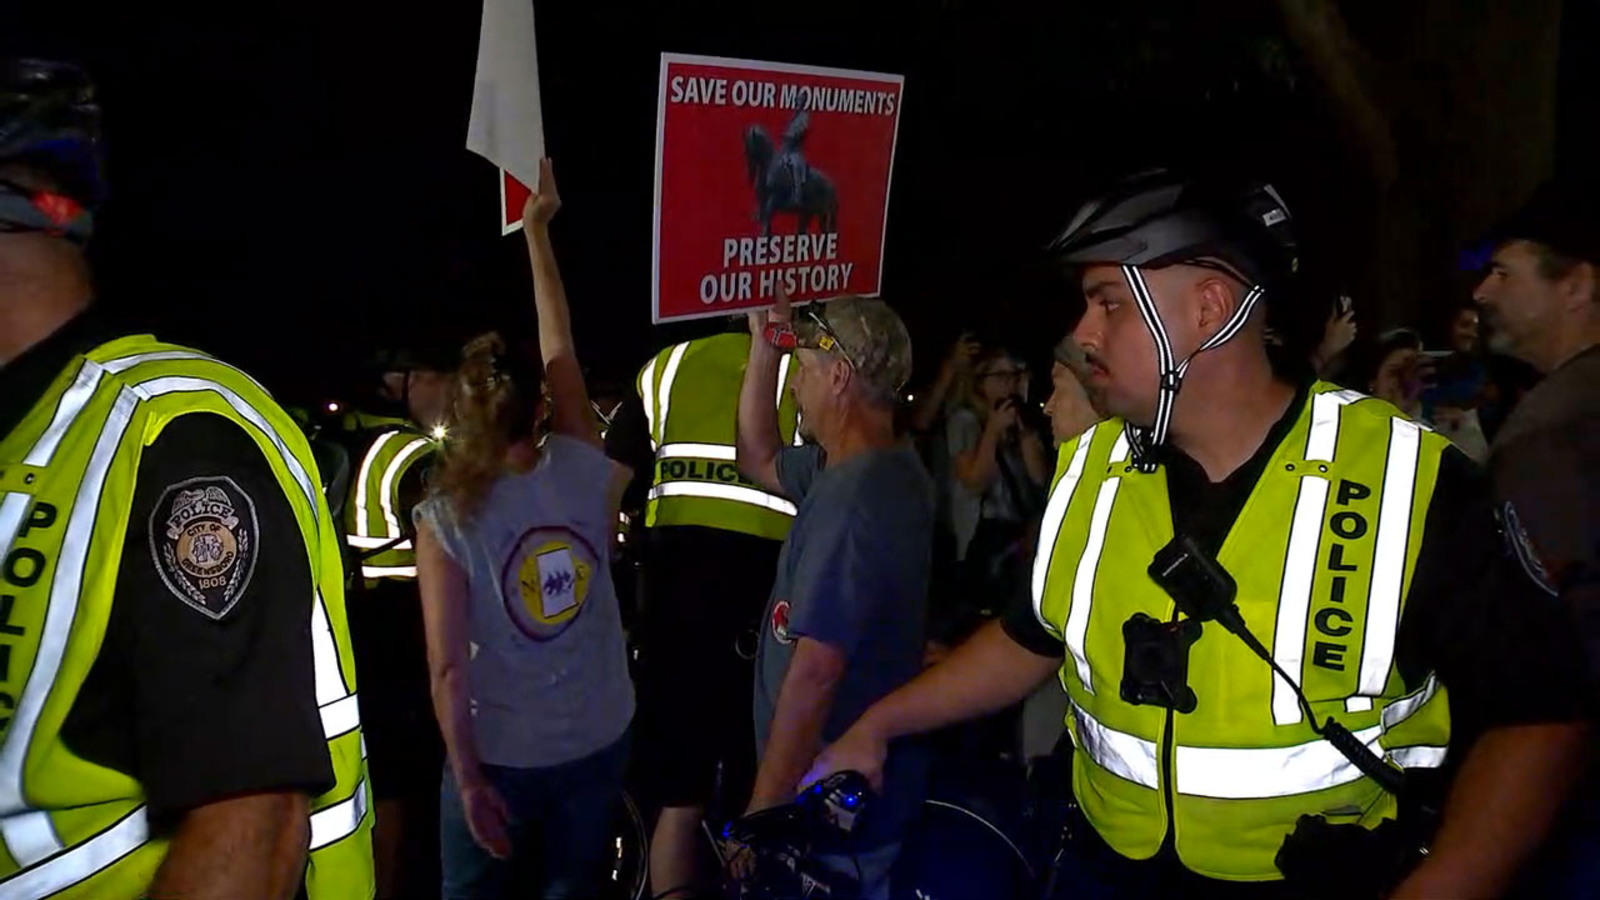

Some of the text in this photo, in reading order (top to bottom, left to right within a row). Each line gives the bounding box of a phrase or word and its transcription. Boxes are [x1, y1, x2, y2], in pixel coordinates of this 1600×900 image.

[671, 76, 895, 115] SAVE OUR MONUMENTS
[723, 233, 838, 268] PRESERVE
[700, 272, 752, 305] OUR
[661, 460, 741, 481] POLIC
[171, 502, 232, 526] POLICE
[187, 523, 222, 537] CITY OF
[198, 576, 227, 590] 1808
[1312, 479, 1371, 673] POLICE
